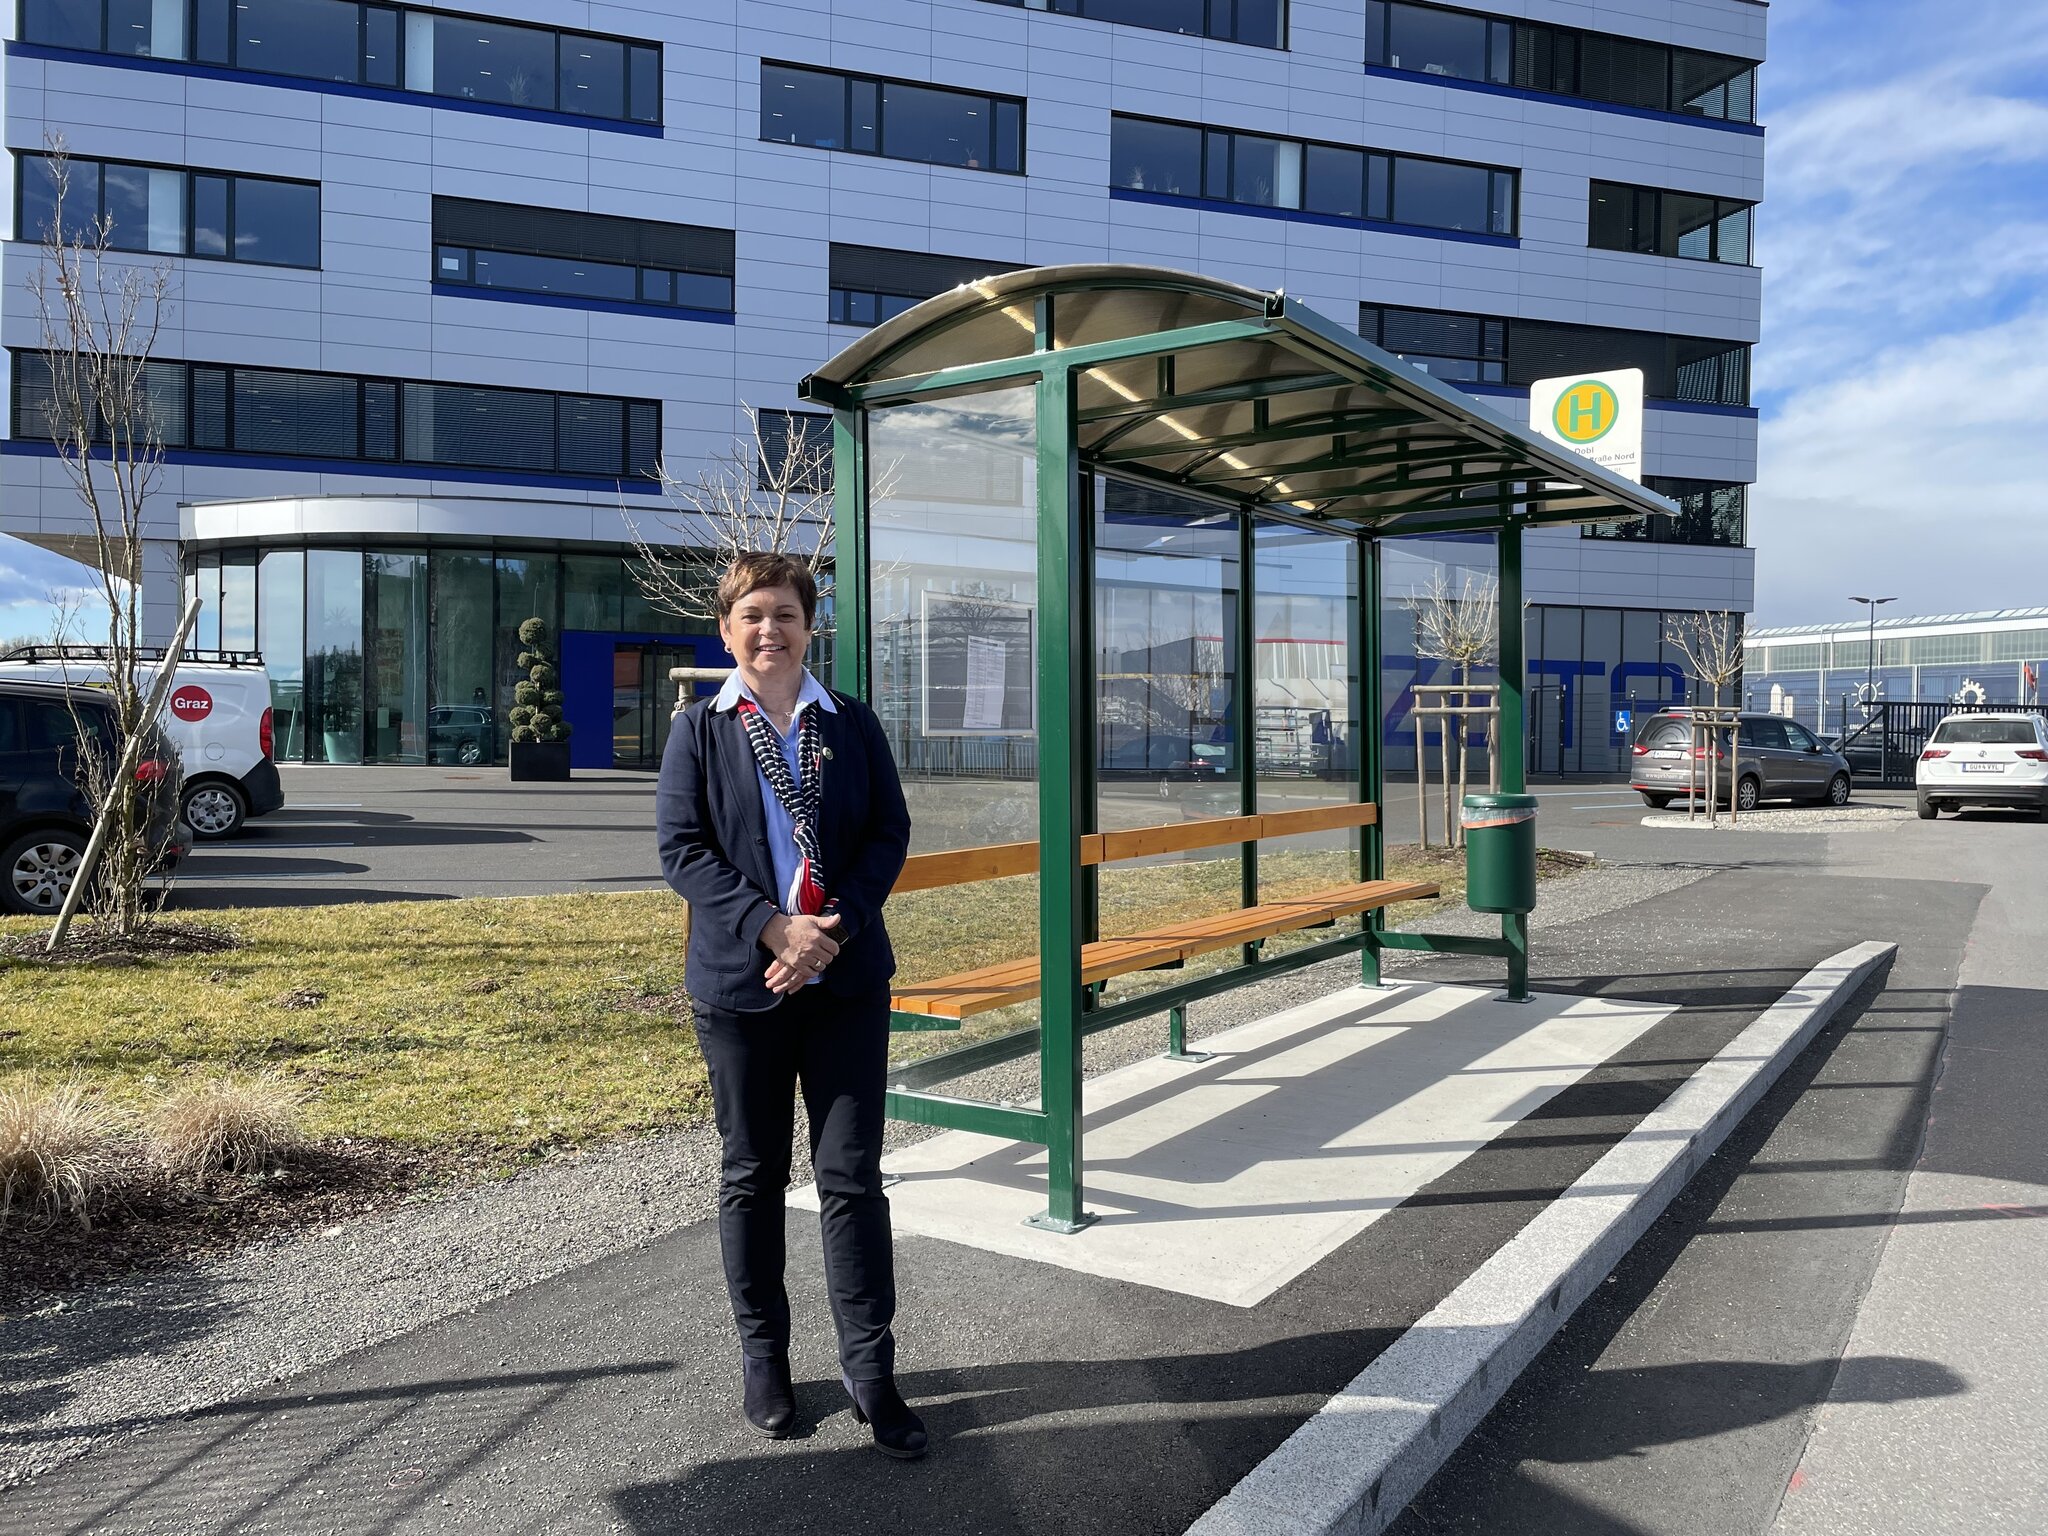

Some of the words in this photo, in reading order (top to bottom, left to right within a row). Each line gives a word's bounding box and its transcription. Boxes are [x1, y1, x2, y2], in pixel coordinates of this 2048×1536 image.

[1569, 392, 1601, 432] H
[1614, 452, 1635, 460] Nord
[175, 698, 208, 709] Graz
